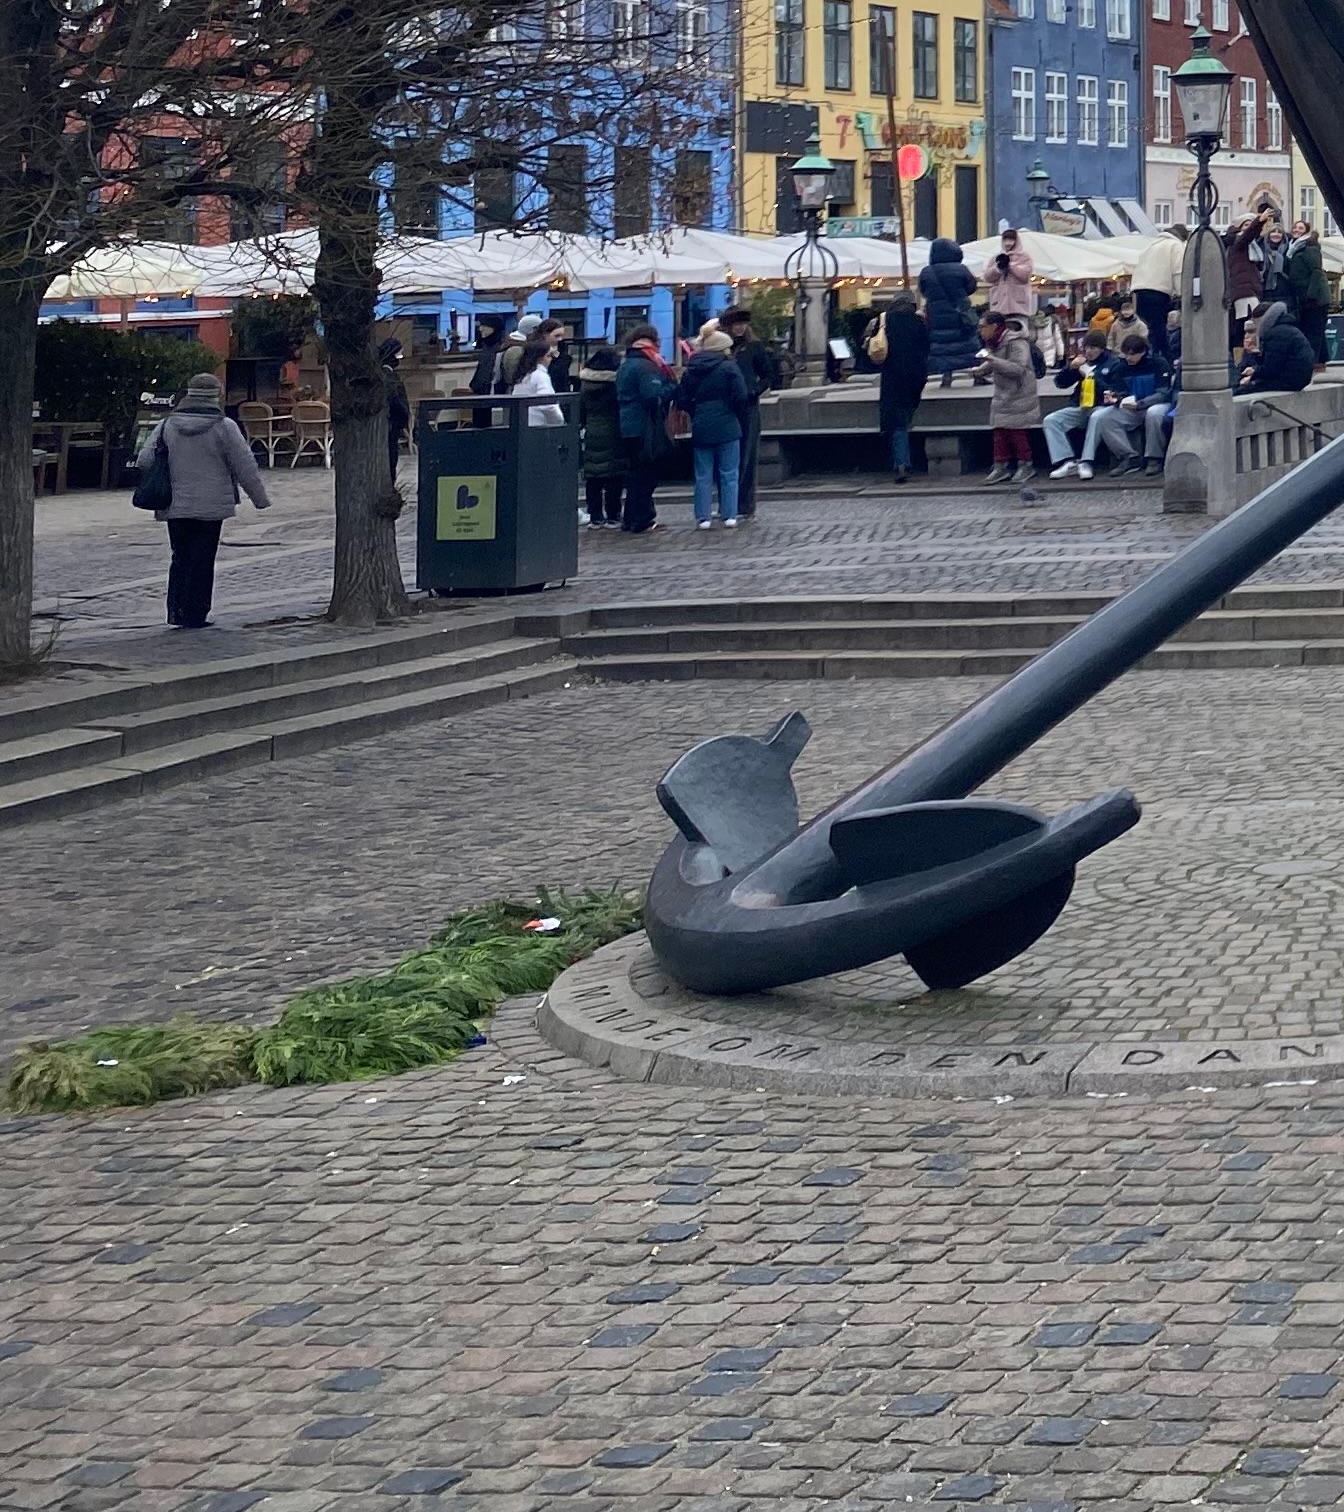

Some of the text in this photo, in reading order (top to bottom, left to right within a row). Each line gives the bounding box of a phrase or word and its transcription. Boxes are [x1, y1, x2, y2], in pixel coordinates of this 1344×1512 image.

[570, 985, 691, 1041] MINDE
[707, 1036, 822, 1062] OM
[857, 1050, 1049, 1068] DEN
